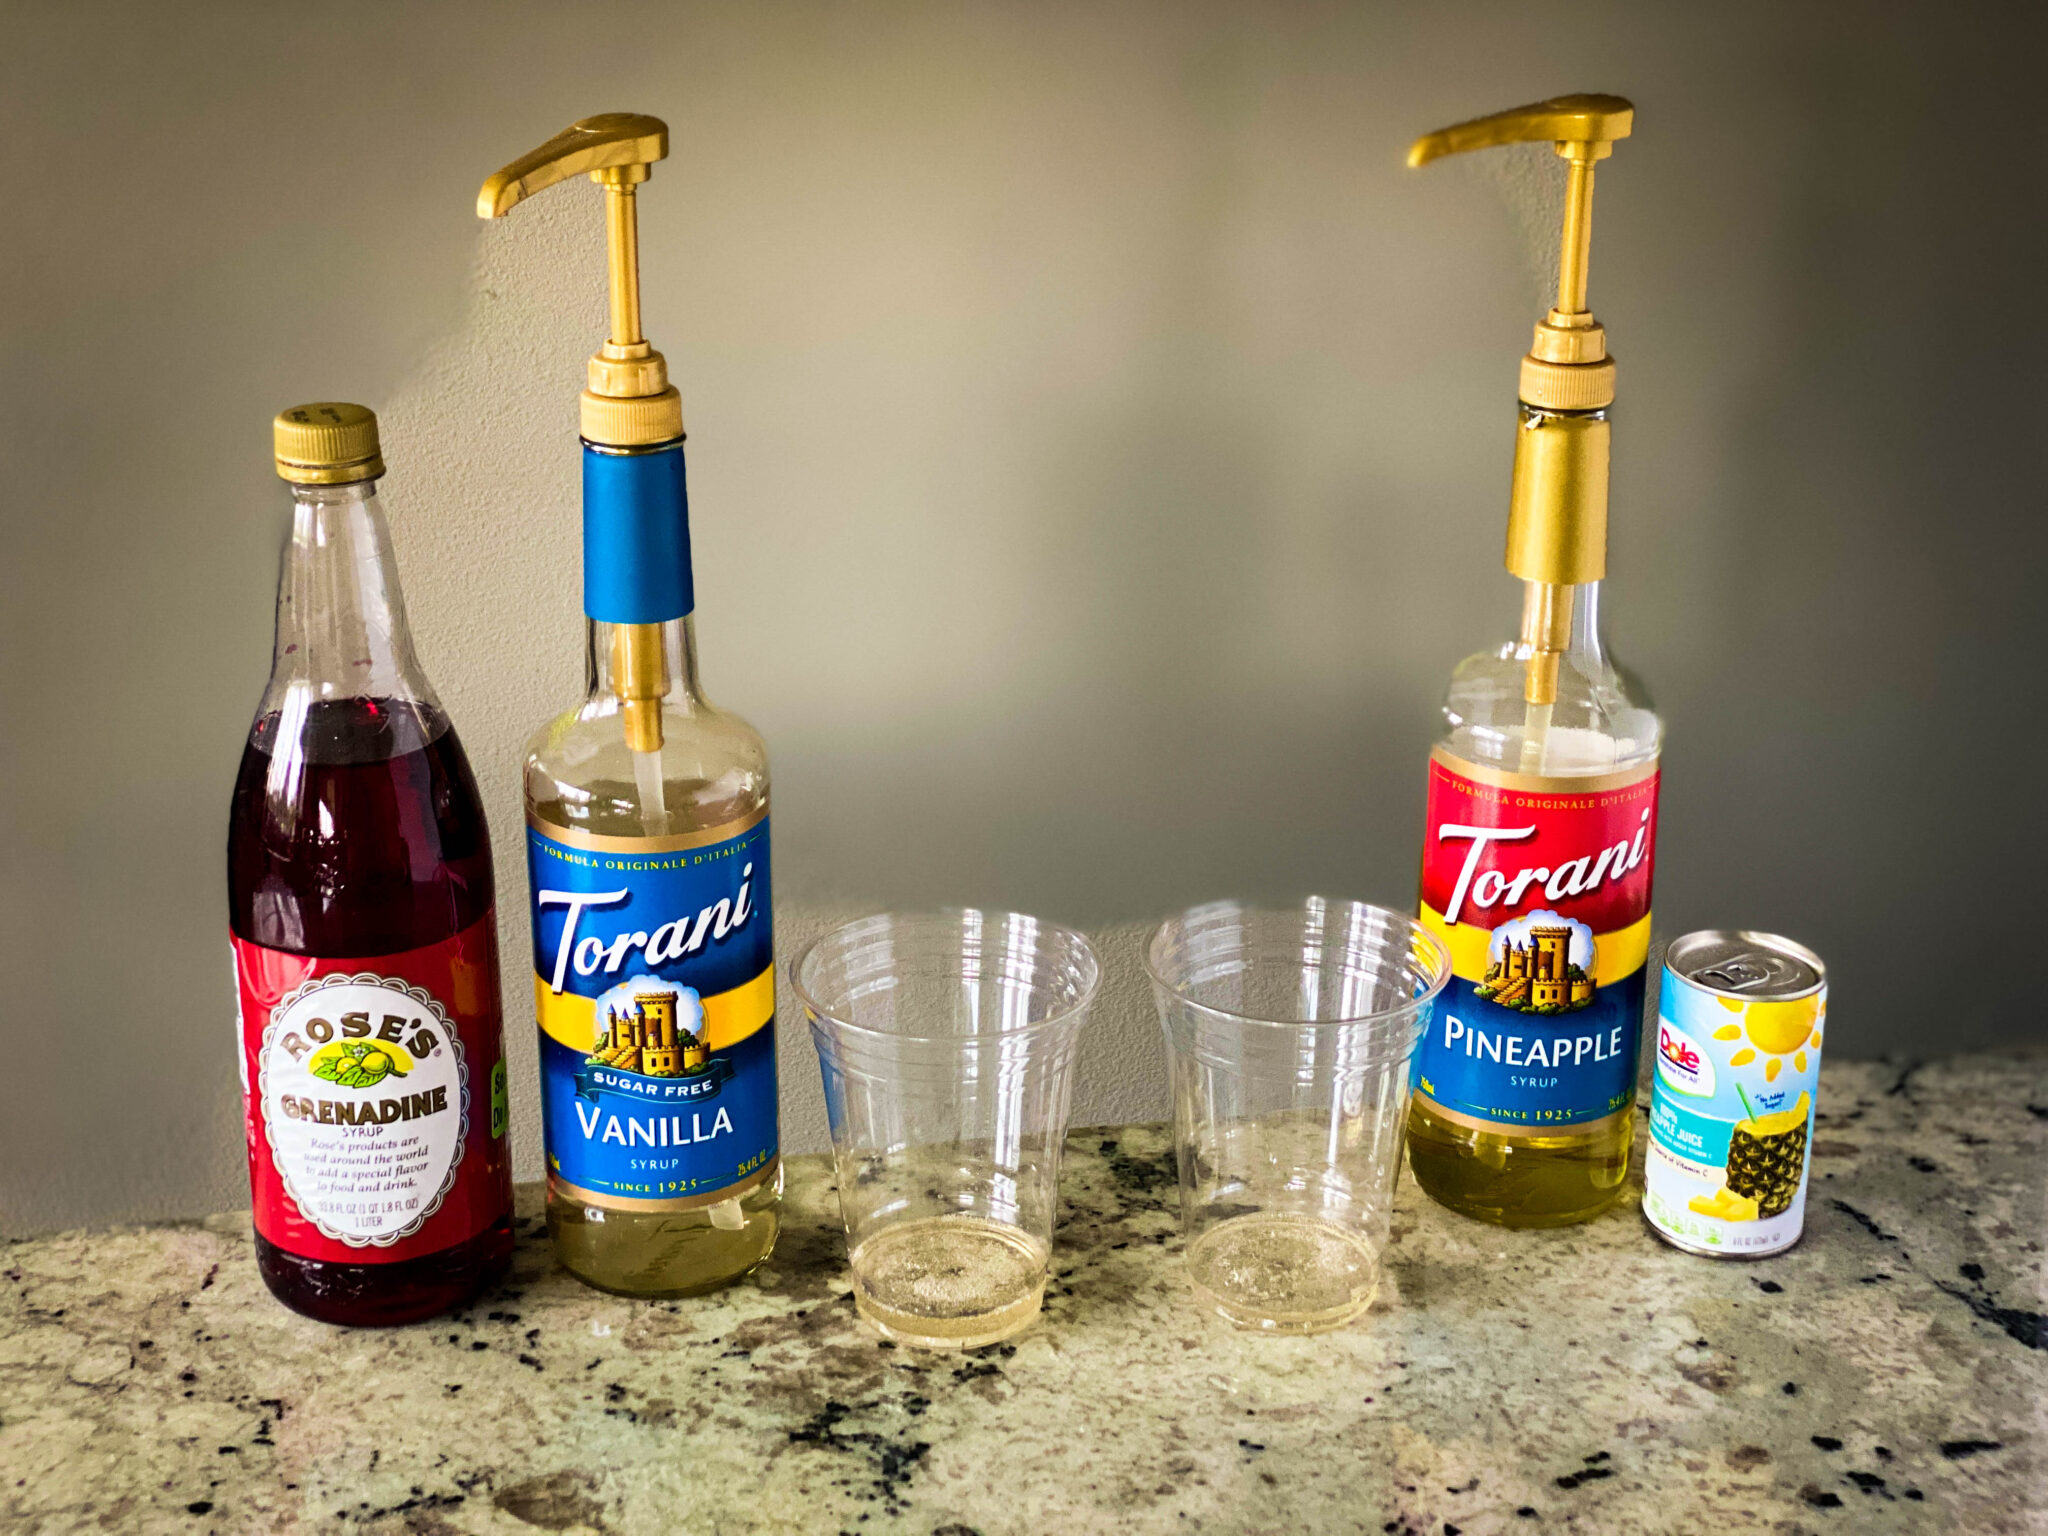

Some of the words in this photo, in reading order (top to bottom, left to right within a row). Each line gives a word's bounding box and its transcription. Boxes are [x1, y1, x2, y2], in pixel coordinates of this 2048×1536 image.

[1452, 780, 1510, 805] FORMULA
[1515, 797, 1596, 810] ORIGINALE
[1600, 787, 1648, 808] D'ITALIA
[544, 844, 598, 868] FORMULA
[605, 858, 687, 871] ORIGINALE
[694, 841, 747, 865] D'ITALIA
[1438, 807, 1650, 924] Torani
[538, 862, 754, 994] Torani
[280, 1012, 440, 1062] ROSE'S
[1444, 1014, 1623, 1069] PINEAPPLE
[1660, 1026, 1700, 1069] Dole
[593, 1071, 658, 1096] SUGAR
[664, 1079, 713, 1097] FREE
[1511, 1075, 1559, 1087] SYRUP
[280, 1085, 448, 1126] GRENADINE
[1490, 1108, 1528, 1120] SINCE
[1535, 1108, 1573, 1121] 1925
[342, 1126, 384, 1138] SYRUP
[574, 1101, 734, 1147] VANILLA
[311, 1138, 344, 1150] Rose's
[348, 1139, 397, 1153] products
[401, 1136, 419, 1145] are
[1677, 1128, 1703, 1148] JUICE
[304, 1153, 326, 1163] used
[330, 1155, 370, 1165] around
[374, 1153, 392, 1164] the
[396, 1145, 429, 1161] world
[630, 1158, 679, 1170] SYRUP
[318, 1168, 338, 1178] add
[352, 1167, 391, 1181] special
[394, 1162, 429, 1179] flavor
[737, 1160, 751, 1177] 25.4
[1702, 1168, 1708, 1178] C
[329, 1181, 354, 1194] food
[358, 1181, 380, 1192] and
[383, 1177, 417, 1192] drink.
[613, 1181, 650, 1193] SINCE
[659, 1178, 697, 1193] 1925
[336, 1203, 345, 1214] FL
[346, 1203, 356, 1214] OZ
[368, 1202, 378, 1214] QT
[382, 1202, 393, 1213] 1.8
[395, 1201, 404, 1213] FL
[361, 1216, 382, 1228] LITER
